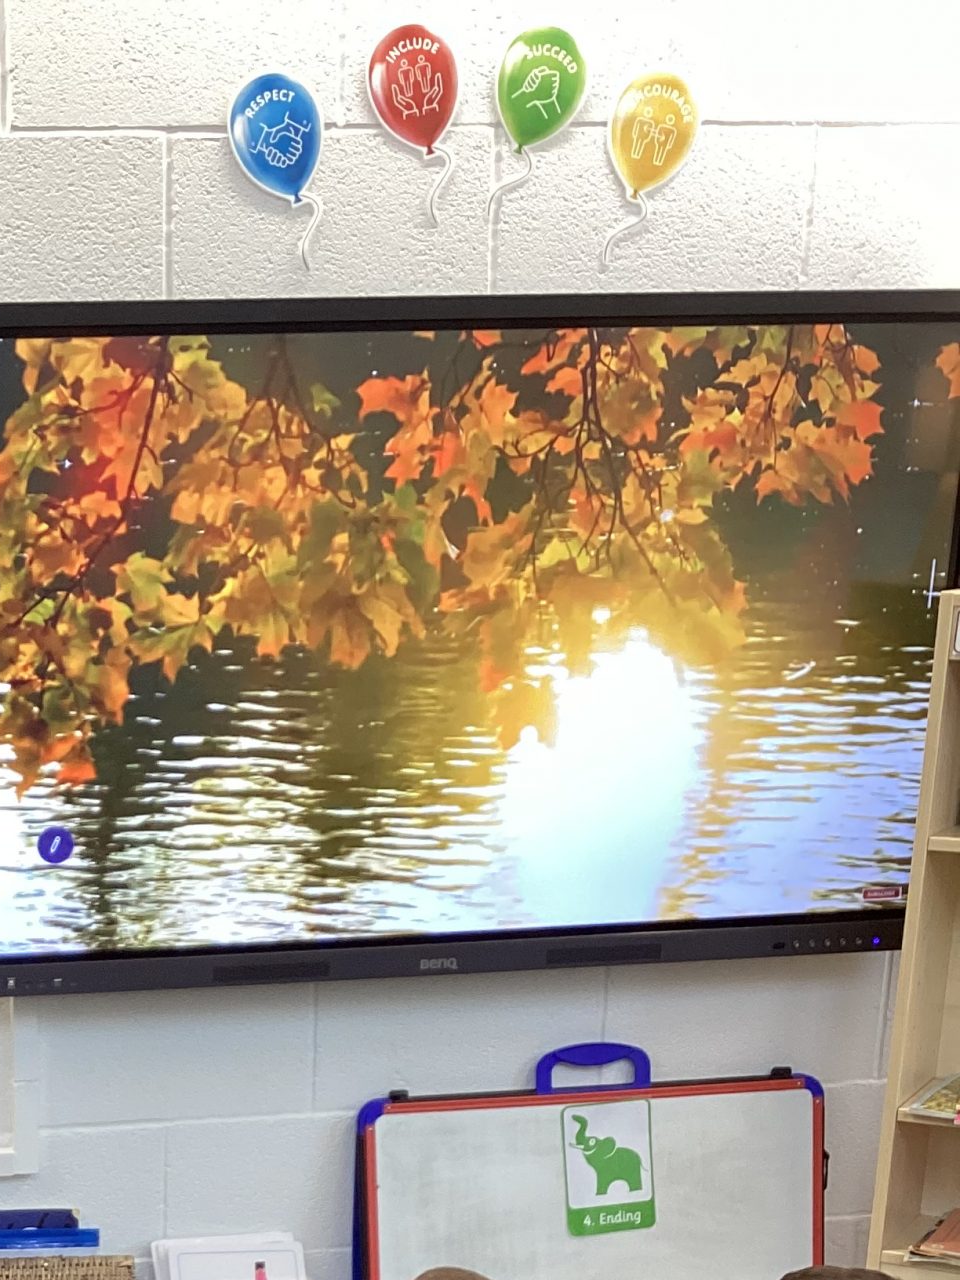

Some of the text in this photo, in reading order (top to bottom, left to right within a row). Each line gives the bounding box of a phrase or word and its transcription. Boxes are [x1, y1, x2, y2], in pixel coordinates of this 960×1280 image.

[385, 37, 441, 64] INCLUDE
[526, 44, 578, 74] SUCCEED
[245, 89, 296, 119] RESPECT
[583, 1210, 642, 1227] 4. Ending
